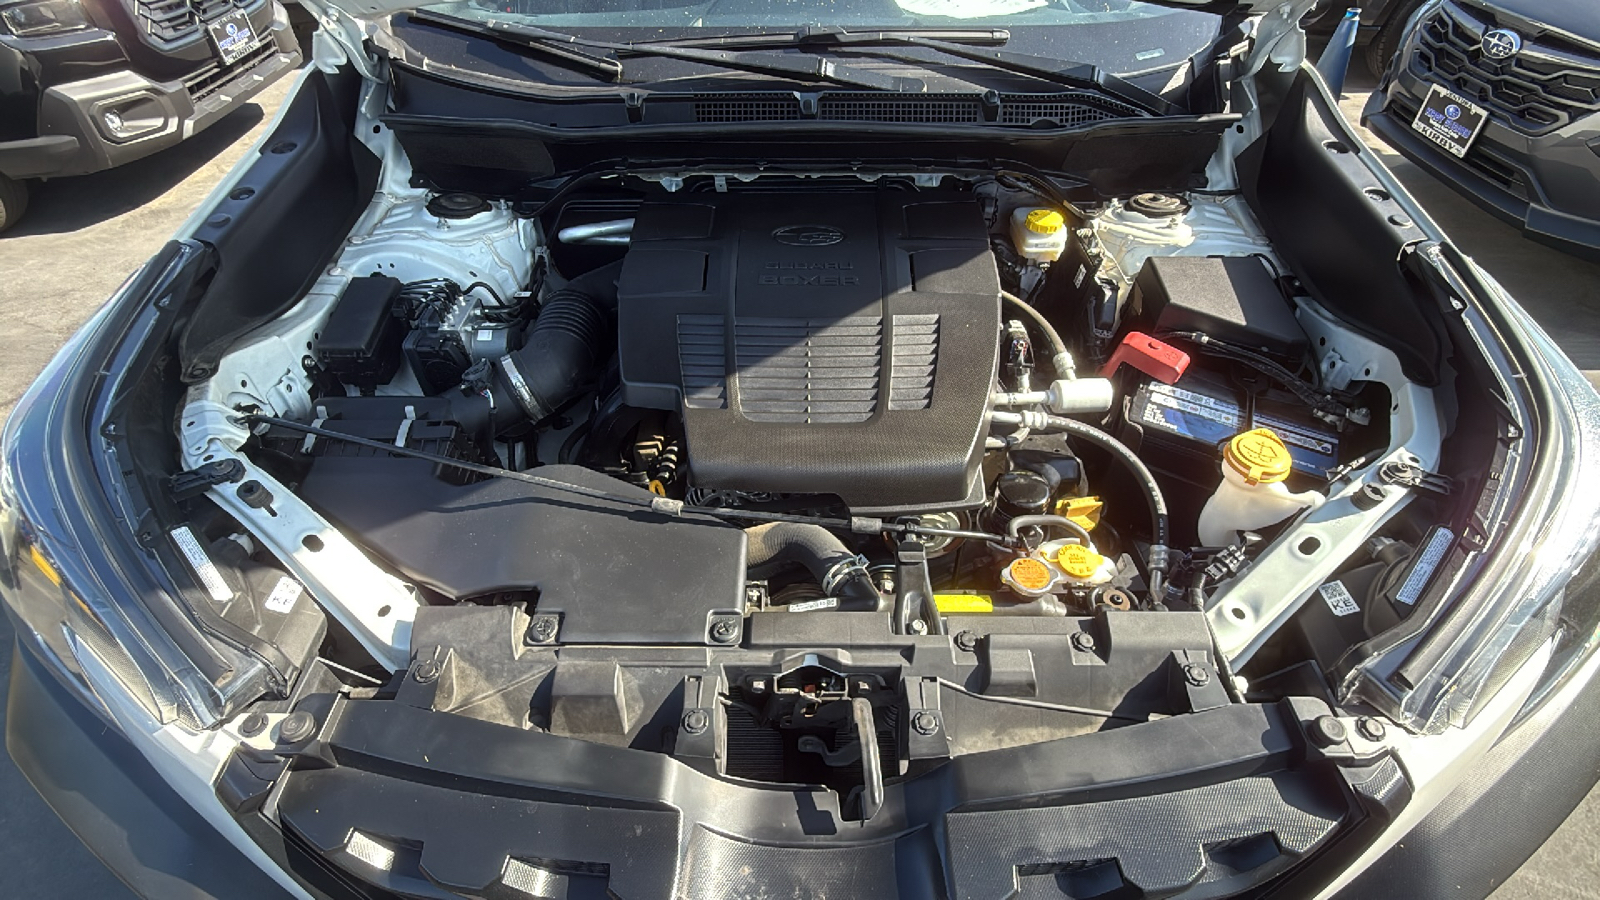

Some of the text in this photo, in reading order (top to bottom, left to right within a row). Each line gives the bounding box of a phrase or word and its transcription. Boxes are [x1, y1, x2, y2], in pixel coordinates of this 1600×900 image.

[1420, 126, 1456, 150] KIRBY
[765, 261, 854, 269] SUBARU
[758, 274, 860, 286] BOXER
